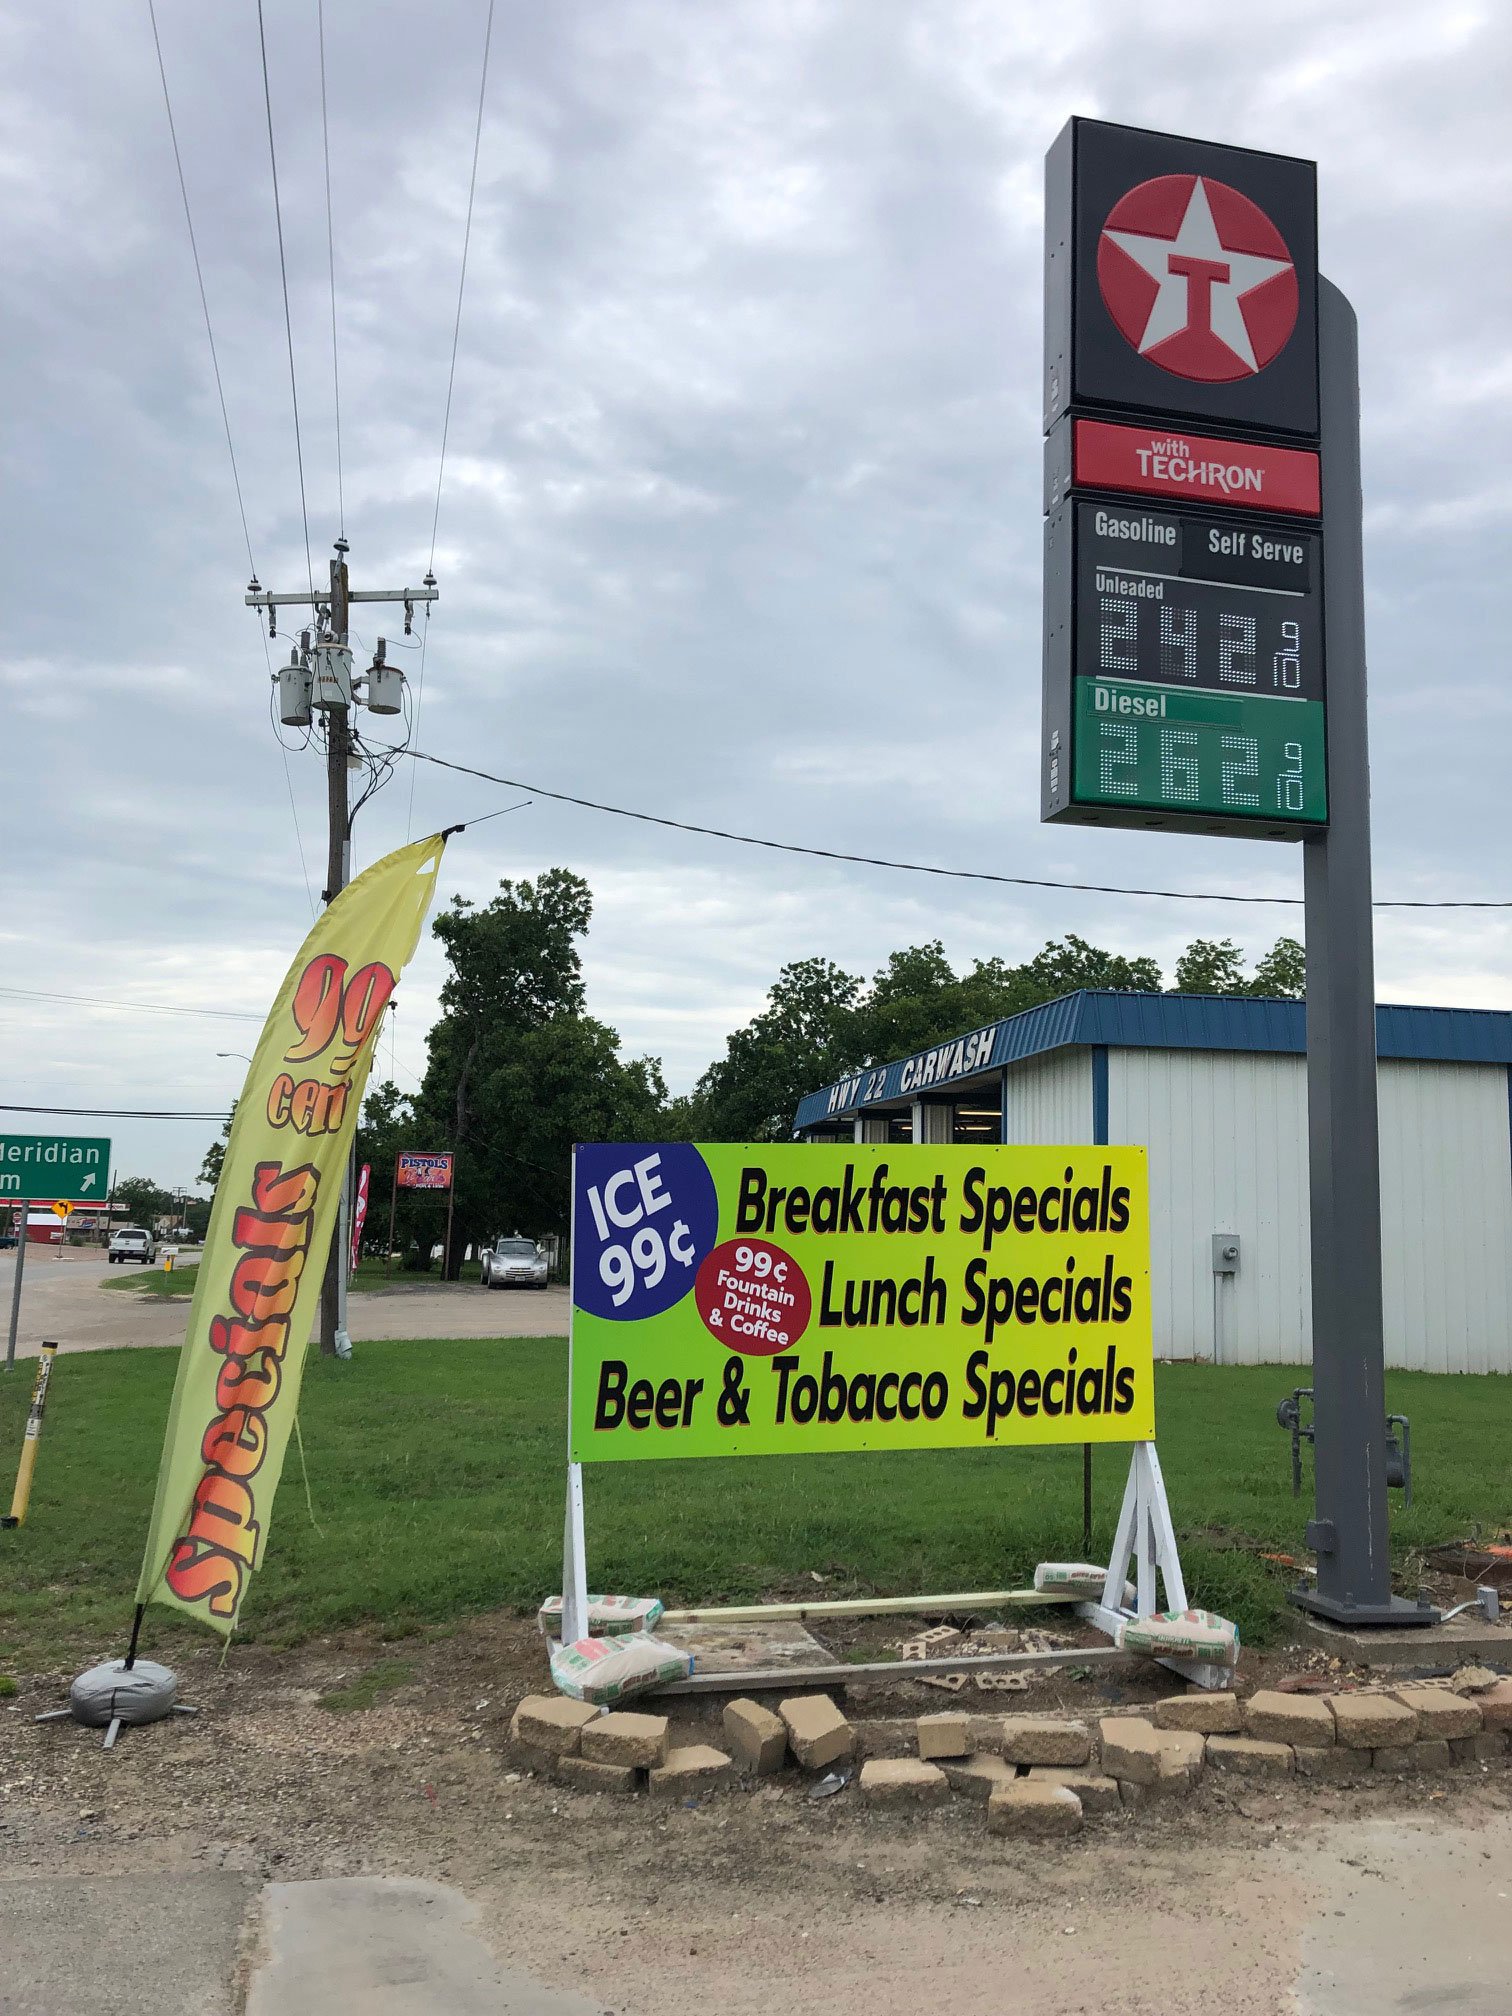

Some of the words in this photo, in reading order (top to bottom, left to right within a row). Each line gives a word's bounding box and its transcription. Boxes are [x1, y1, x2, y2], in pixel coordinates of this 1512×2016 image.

[1136, 449, 1262, 493] TECHRON
[1151, 438, 1189, 457] with
[1095, 511, 1176, 545] Gasoline
[1209, 529, 1246, 556] Self
[1252, 535, 1303, 564] Serve
[1095, 573, 1164, 600] Unleaded
[1095, 687, 1166, 718] Diesel
[827, 1077, 860, 1114] HWY
[864, 1068, 887, 1102] 22
[900, 1027, 996, 1093] CARWASH
[267, 1072, 354, 1137] cen
[401, 1157, 448, 1170] PISTOLS
[587, 1152, 672, 1242] ICE
[735, 1163, 947, 1235] Breakfast
[959, 1165, 1131, 1252] Specials
[599, 1220, 696, 1307] 99¢
[734, 1246, 789, 1283] 99¢
[717, 1269, 795, 1307] Fountain
[723, 1291, 782, 1323] Drinks
[819, 1256, 947, 1328] Lunch
[961, 1254, 1132, 1344] Specials
[709, 1308, 723, 1328] &
[730, 1315, 789, 1346] Coffee
[165, 1160, 322, 1619] Specials
[594, 1360, 704, 1431] Beer
[717, 1355, 751, 1428] &
[771, 1351, 949, 1425] Tobacco
[962, 1345, 1135, 1439] Specials
